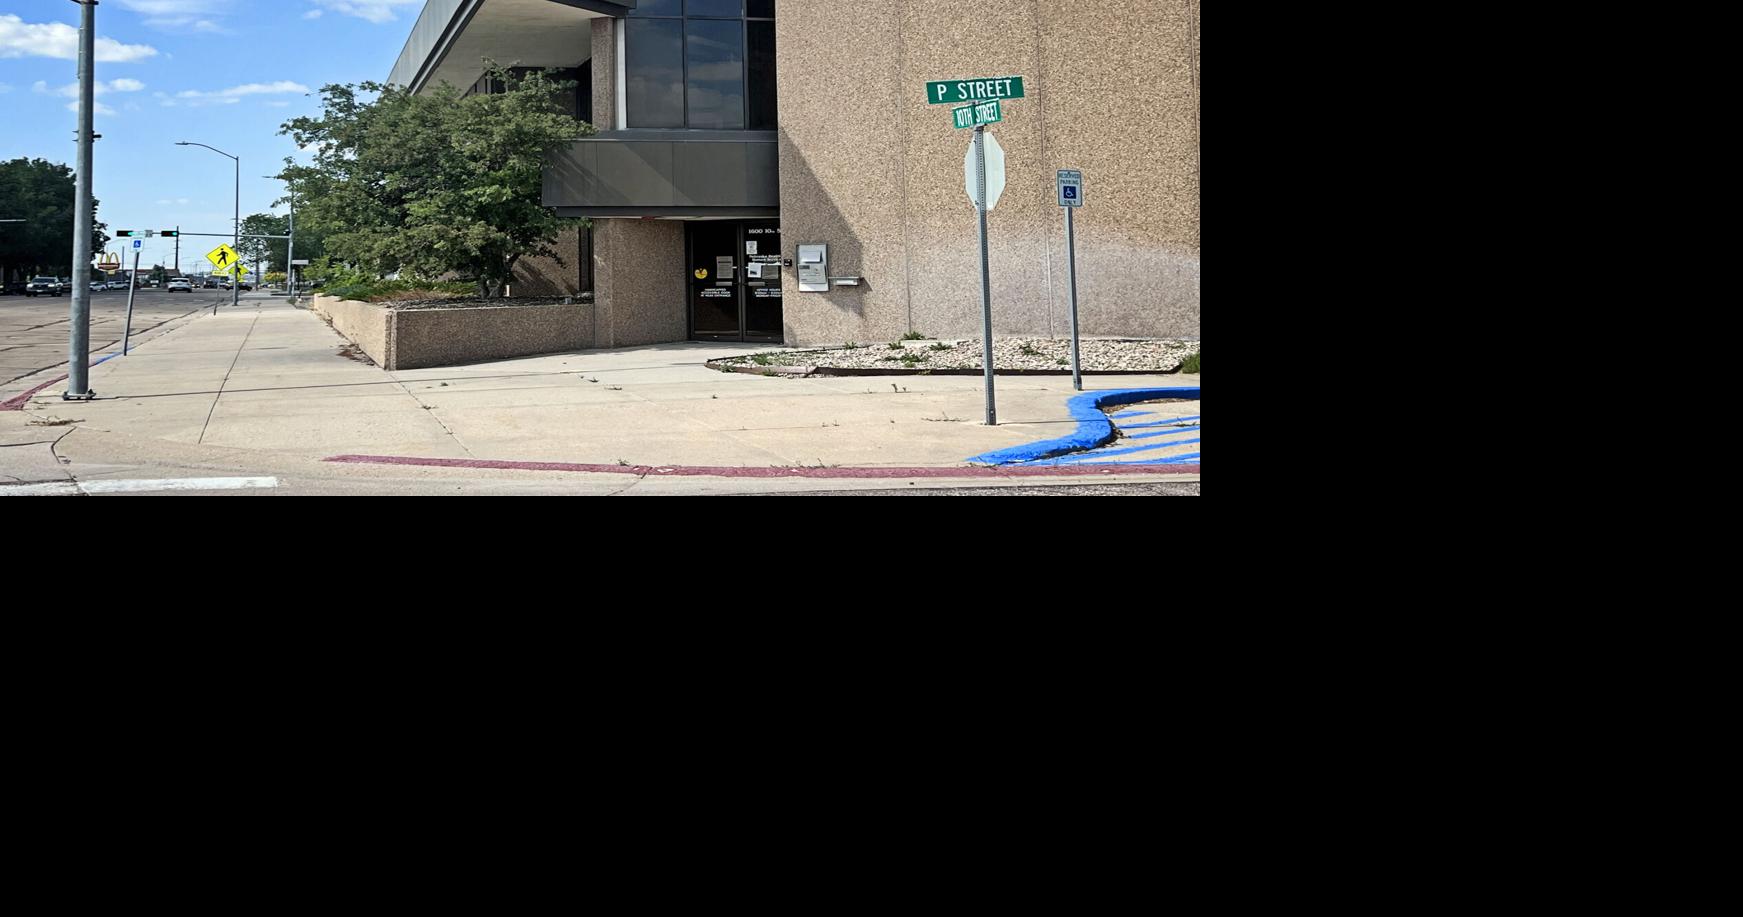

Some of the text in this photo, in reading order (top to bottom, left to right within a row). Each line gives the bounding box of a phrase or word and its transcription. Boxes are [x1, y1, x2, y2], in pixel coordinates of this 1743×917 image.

[937, 80, 1011, 101] P STREET
[956, 102, 998, 126] 10TH STREET
